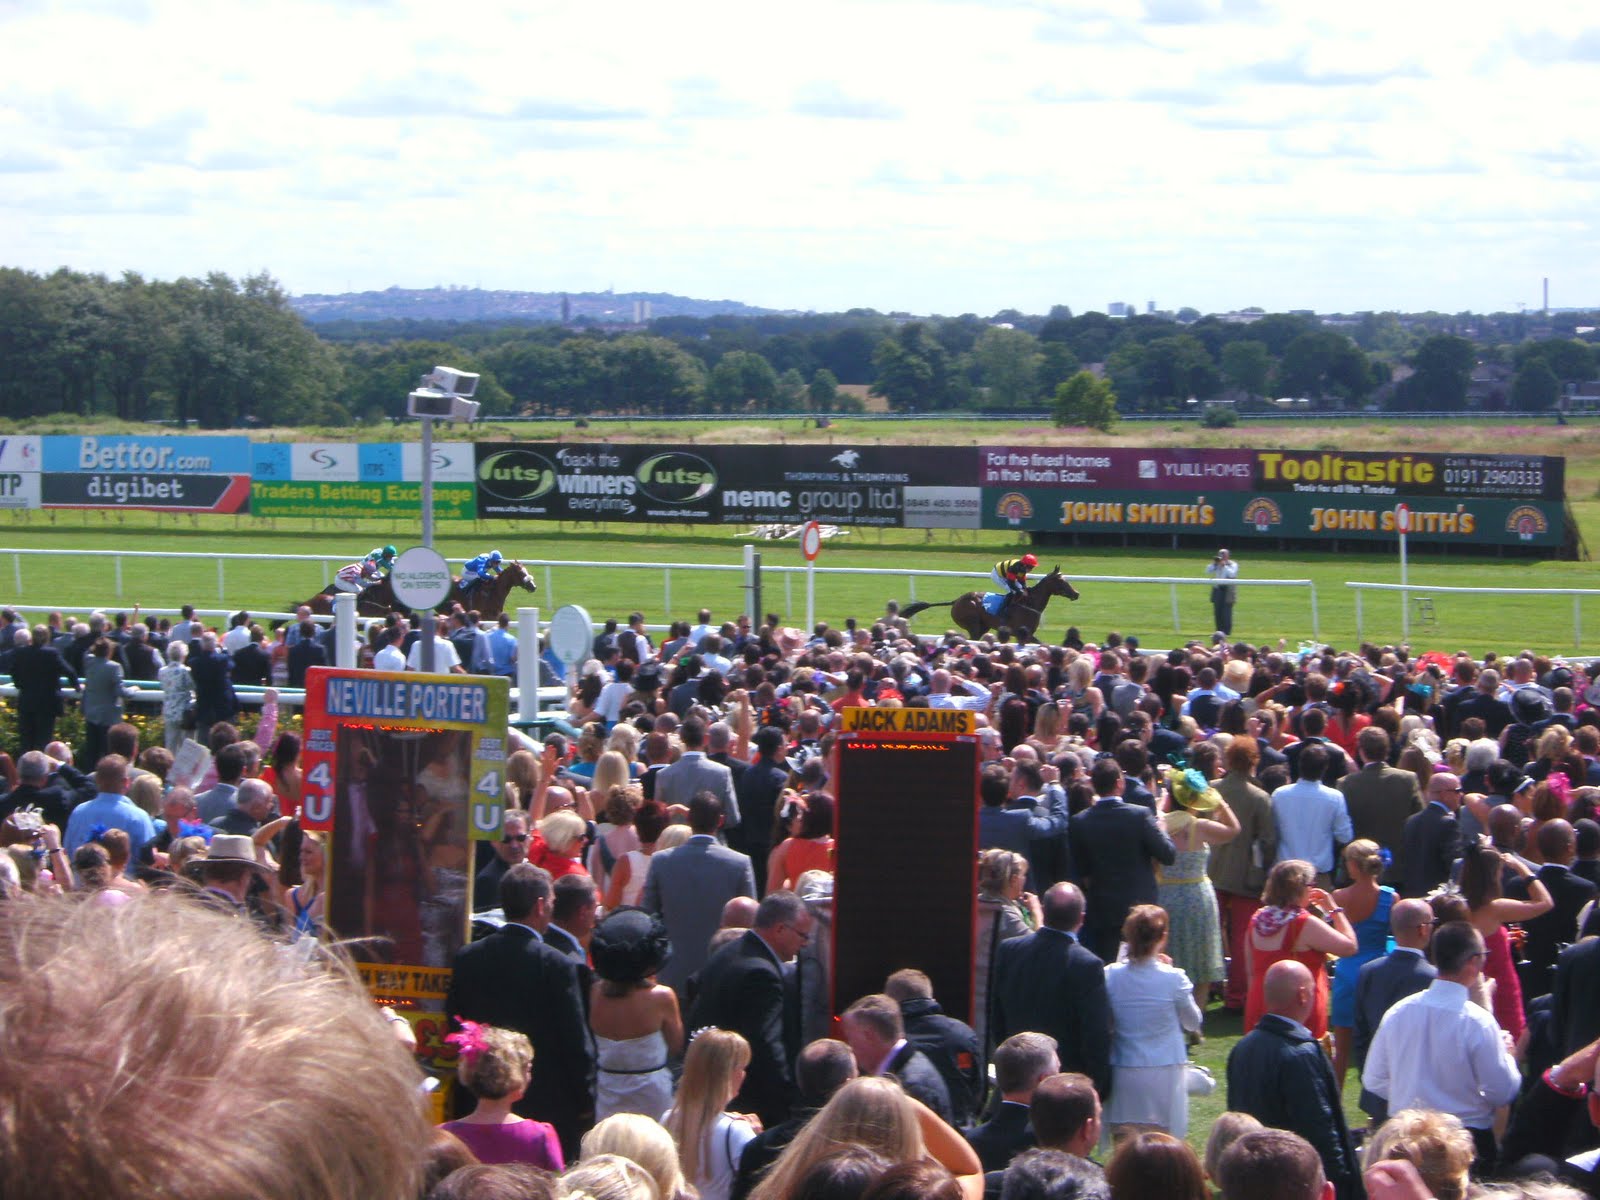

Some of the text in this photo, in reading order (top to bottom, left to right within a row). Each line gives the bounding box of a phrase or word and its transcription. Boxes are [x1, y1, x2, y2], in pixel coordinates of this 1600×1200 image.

[563, 453, 620, 467] back the
[987, 453, 1111, 468] For the finest homes
[1258, 453, 1434, 483] Tooltastic
[494, 466, 540, 481] uts
[557, 468, 636, 495] winners
[655, 468, 702, 484] uts
[987, 469, 999, 481] in
[1001, 469, 1021, 481] the
[1023, 469, 1058, 481] North
[1443, 469, 1543, 485] 0191 2960333
[88, 476, 184, 501] digibet
[252, 483, 472, 505] Traders Betting Excange
[723, 491, 791, 507] nemc
[799, 491, 862, 513] group
[1060, 501, 1123, 525] JOHN
[1127, 496, 1216, 525] SMITH'S
[1309, 508, 1376, 532] JOHN
[328, 680, 485, 720] NEVILLE PORTER
[849, 711, 967, 733] JACK ADAMS
[308, 762, 331, 788] 4
[477, 771, 499, 796] 4
[305, 796, 331, 821] U
[475, 805, 499, 830] U
